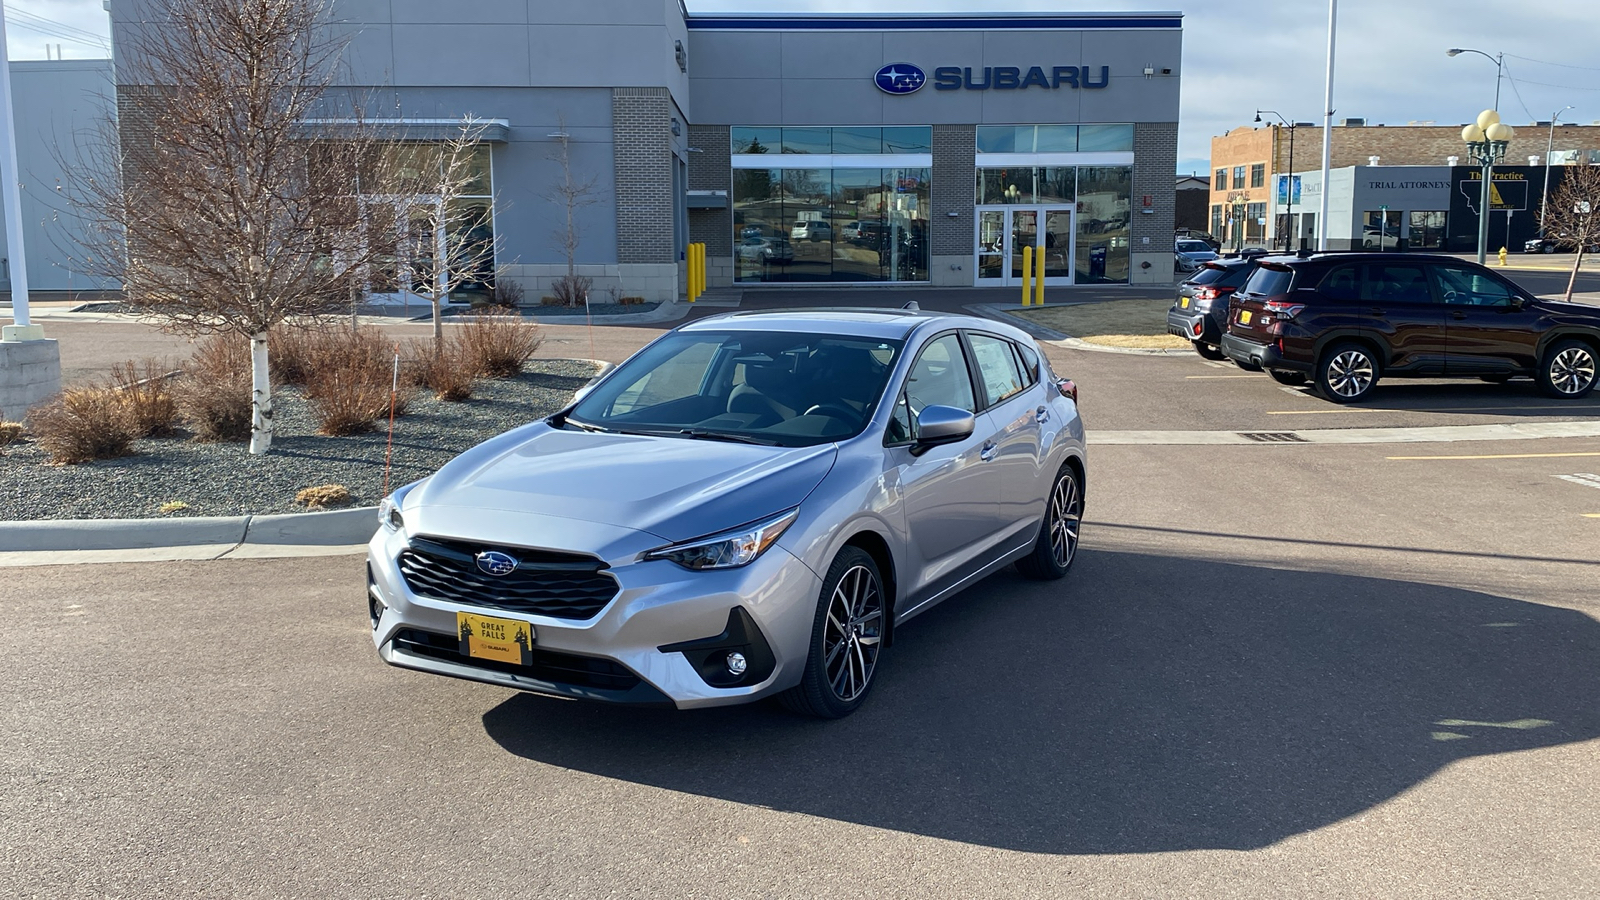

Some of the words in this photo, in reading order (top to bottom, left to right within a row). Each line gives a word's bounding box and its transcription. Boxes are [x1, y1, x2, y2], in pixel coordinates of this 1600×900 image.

[934, 65, 1109, 91] SUBARU
[1469, 171, 1482, 180] Th
[1304, 182, 1322, 193] PRACTI
[1369, 181, 1396, 189] TRIAL
[1398, 181, 1451, 189] ATTORNEYS
[481, 622, 505, 632] GREAT
[482, 630, 506, 640] FALLS
